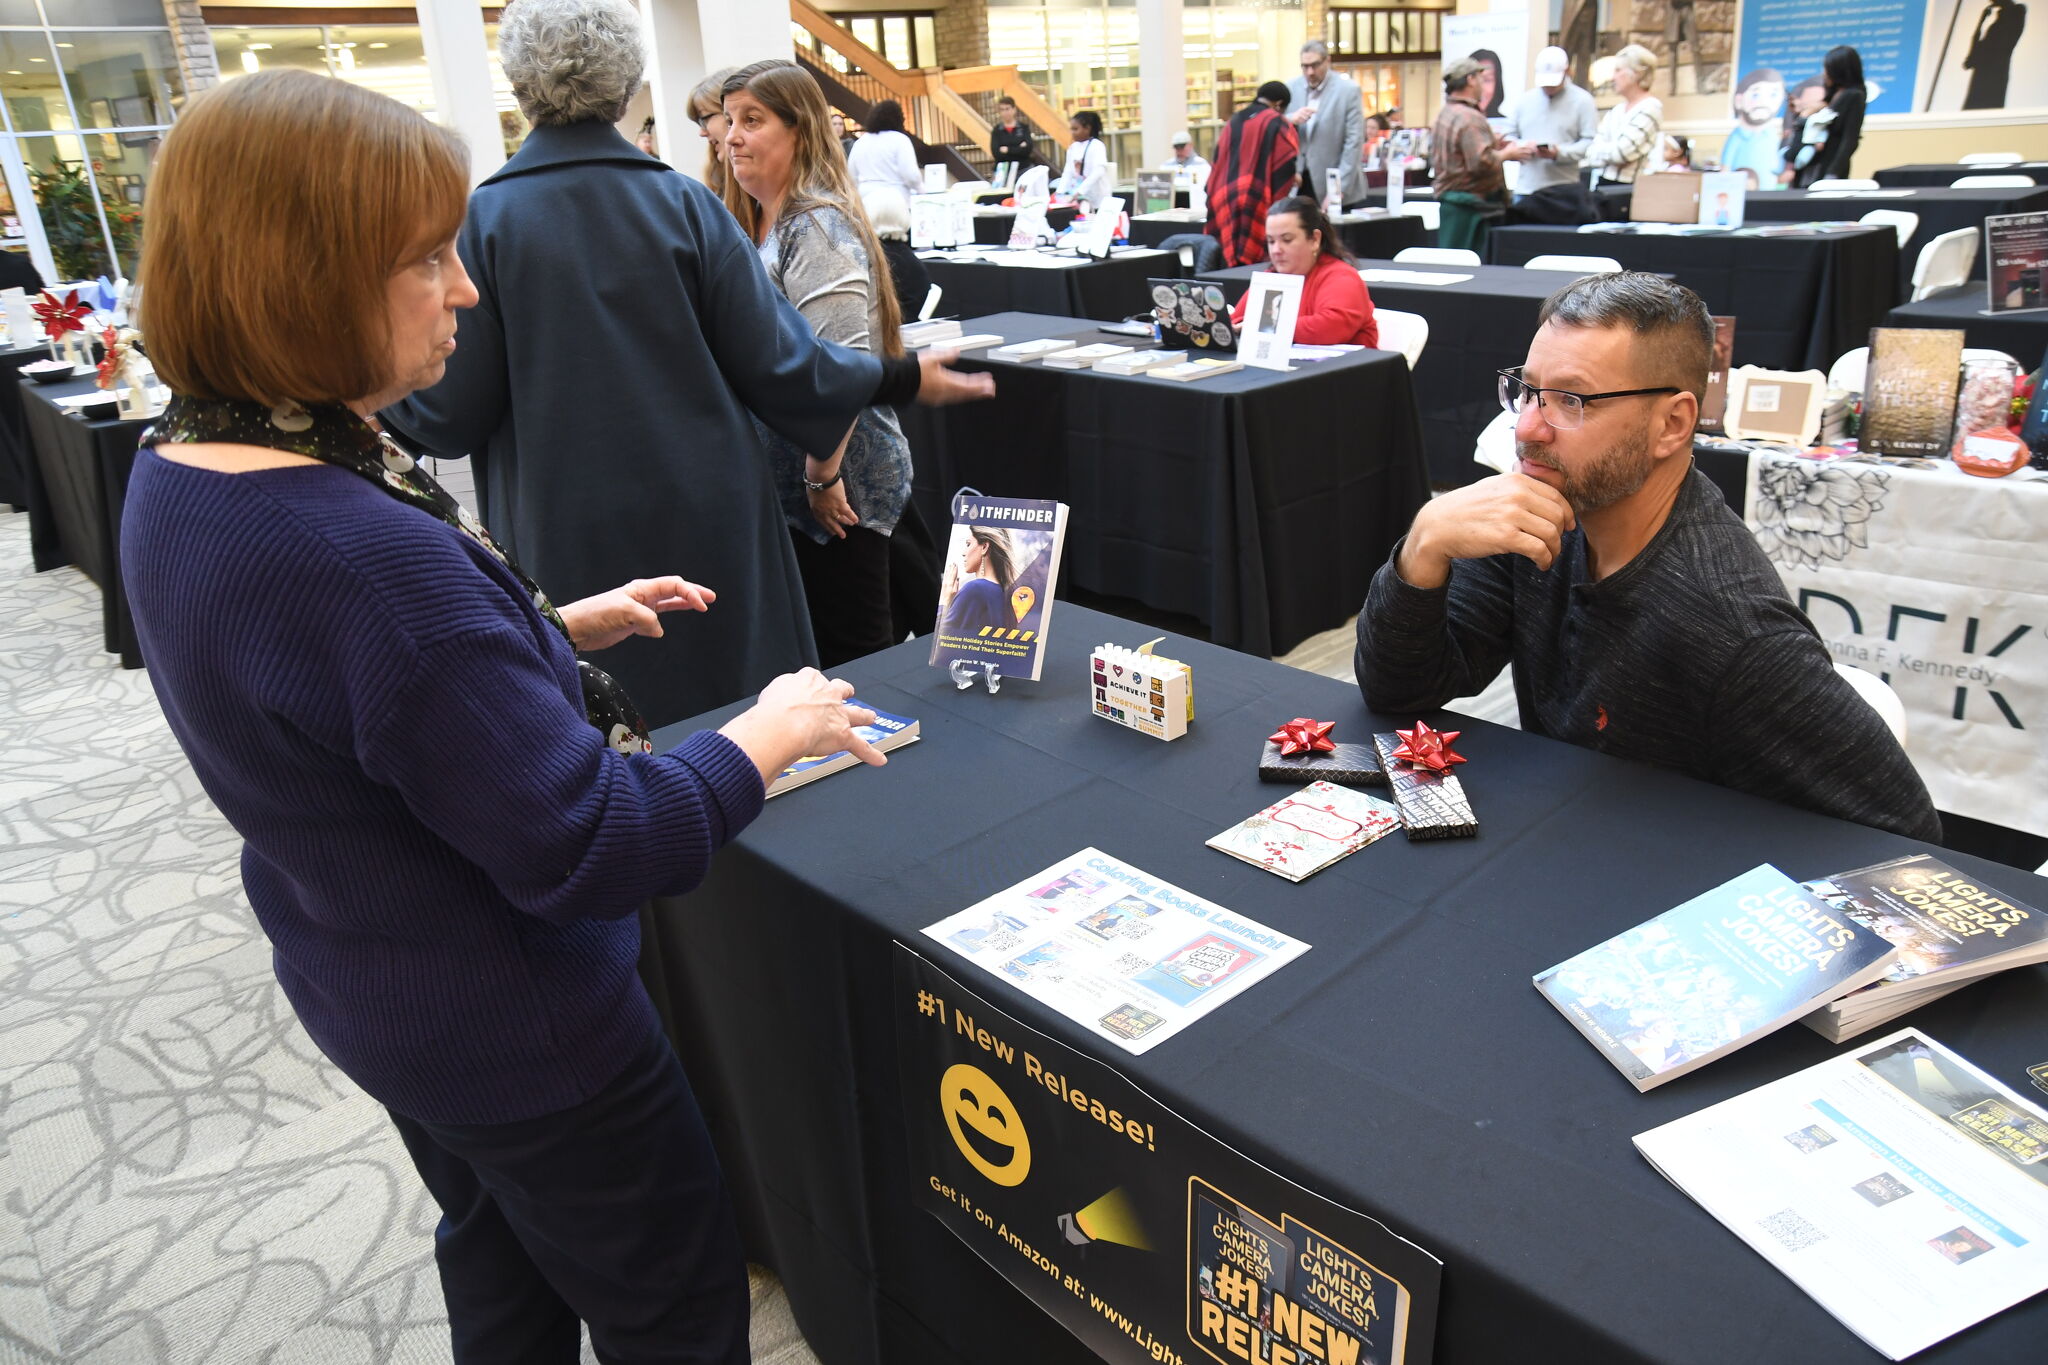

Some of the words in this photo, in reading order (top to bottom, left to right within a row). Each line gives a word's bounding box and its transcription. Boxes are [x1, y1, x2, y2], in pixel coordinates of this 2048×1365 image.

[963, 637, 983, 646] Holiday
[1004, 642, 1029, 651] Empower
[1822, 639, 1869, 661] onna
[1875, 648, 1891, 666] F.
[1898, 653, 1999, 686] Kennedy
[1110, 681, 1139, 696] ACHIEVE
[1110, 695, 1148, 713] TOGETHER
[1087, 858, 1158, 896] Coloring
[1153, 888, 1210, 918] Books
[1207, 912, 1287, 951] Launch!
[1765, 886, 1855, 952] LIGHTS,
[1890, 887, 1986, 937] JOKES!
[1903, 873, 2011, 938] CAMERA,
[1930, 871, 2030, 926] LIGHTS,
[1721, 917, 1809, 976] JOKES!
[1737, 894, 1835, 972] CAMERA,
[1568, 1003, 1589, 1021] AARON
[1593, 1025, 1619, 1049] WEMPLE
[918, 989, 946, 1025] #1
[956, 1008, 1014, 1064] New
[1025, 1052, 1157, 1153] Release!
[1958, 1114, 2038, 1159] RELEASE
[1978, 1113, 2001, 1126] #1
[1999, 1125, 2040, 1147] NEW
[1841, 1121, 1889, 1157] Amazon
[1888, 1151, 1913, 1173] Hot
[1913, 1171, 1945, 1194] New
[1943, 1192, 2001, 1232] Releases
[1212, 1224, 1275, 1275] CAMERA,
[1217, 1212, 1270, 1258] LIGHTS,
[930, 1175, 956, 1203] Get
[961, 1193, 971, 1214] it
[976, 1208, 994, 1229] on
[998, 1223, 1060, 1281] Amazon
[1064, 1275, 1085, 1300] at:
[1090, 1293, 1188, 1365] www.Light
[1219, 1244, 1268, 1284] JOKES!
[1300, 1253, 1380, 1321] CAMERA,
[1306, 1237, 1375, 1295] LIGHTS,
[1201, 1300, 1310, 1365] RELE
[1215, 1263, 1259, 1319] #1
[1274, 1293, 1361, 1365] NEW
[1307, 1279, 1369, 1332] JOKES!
